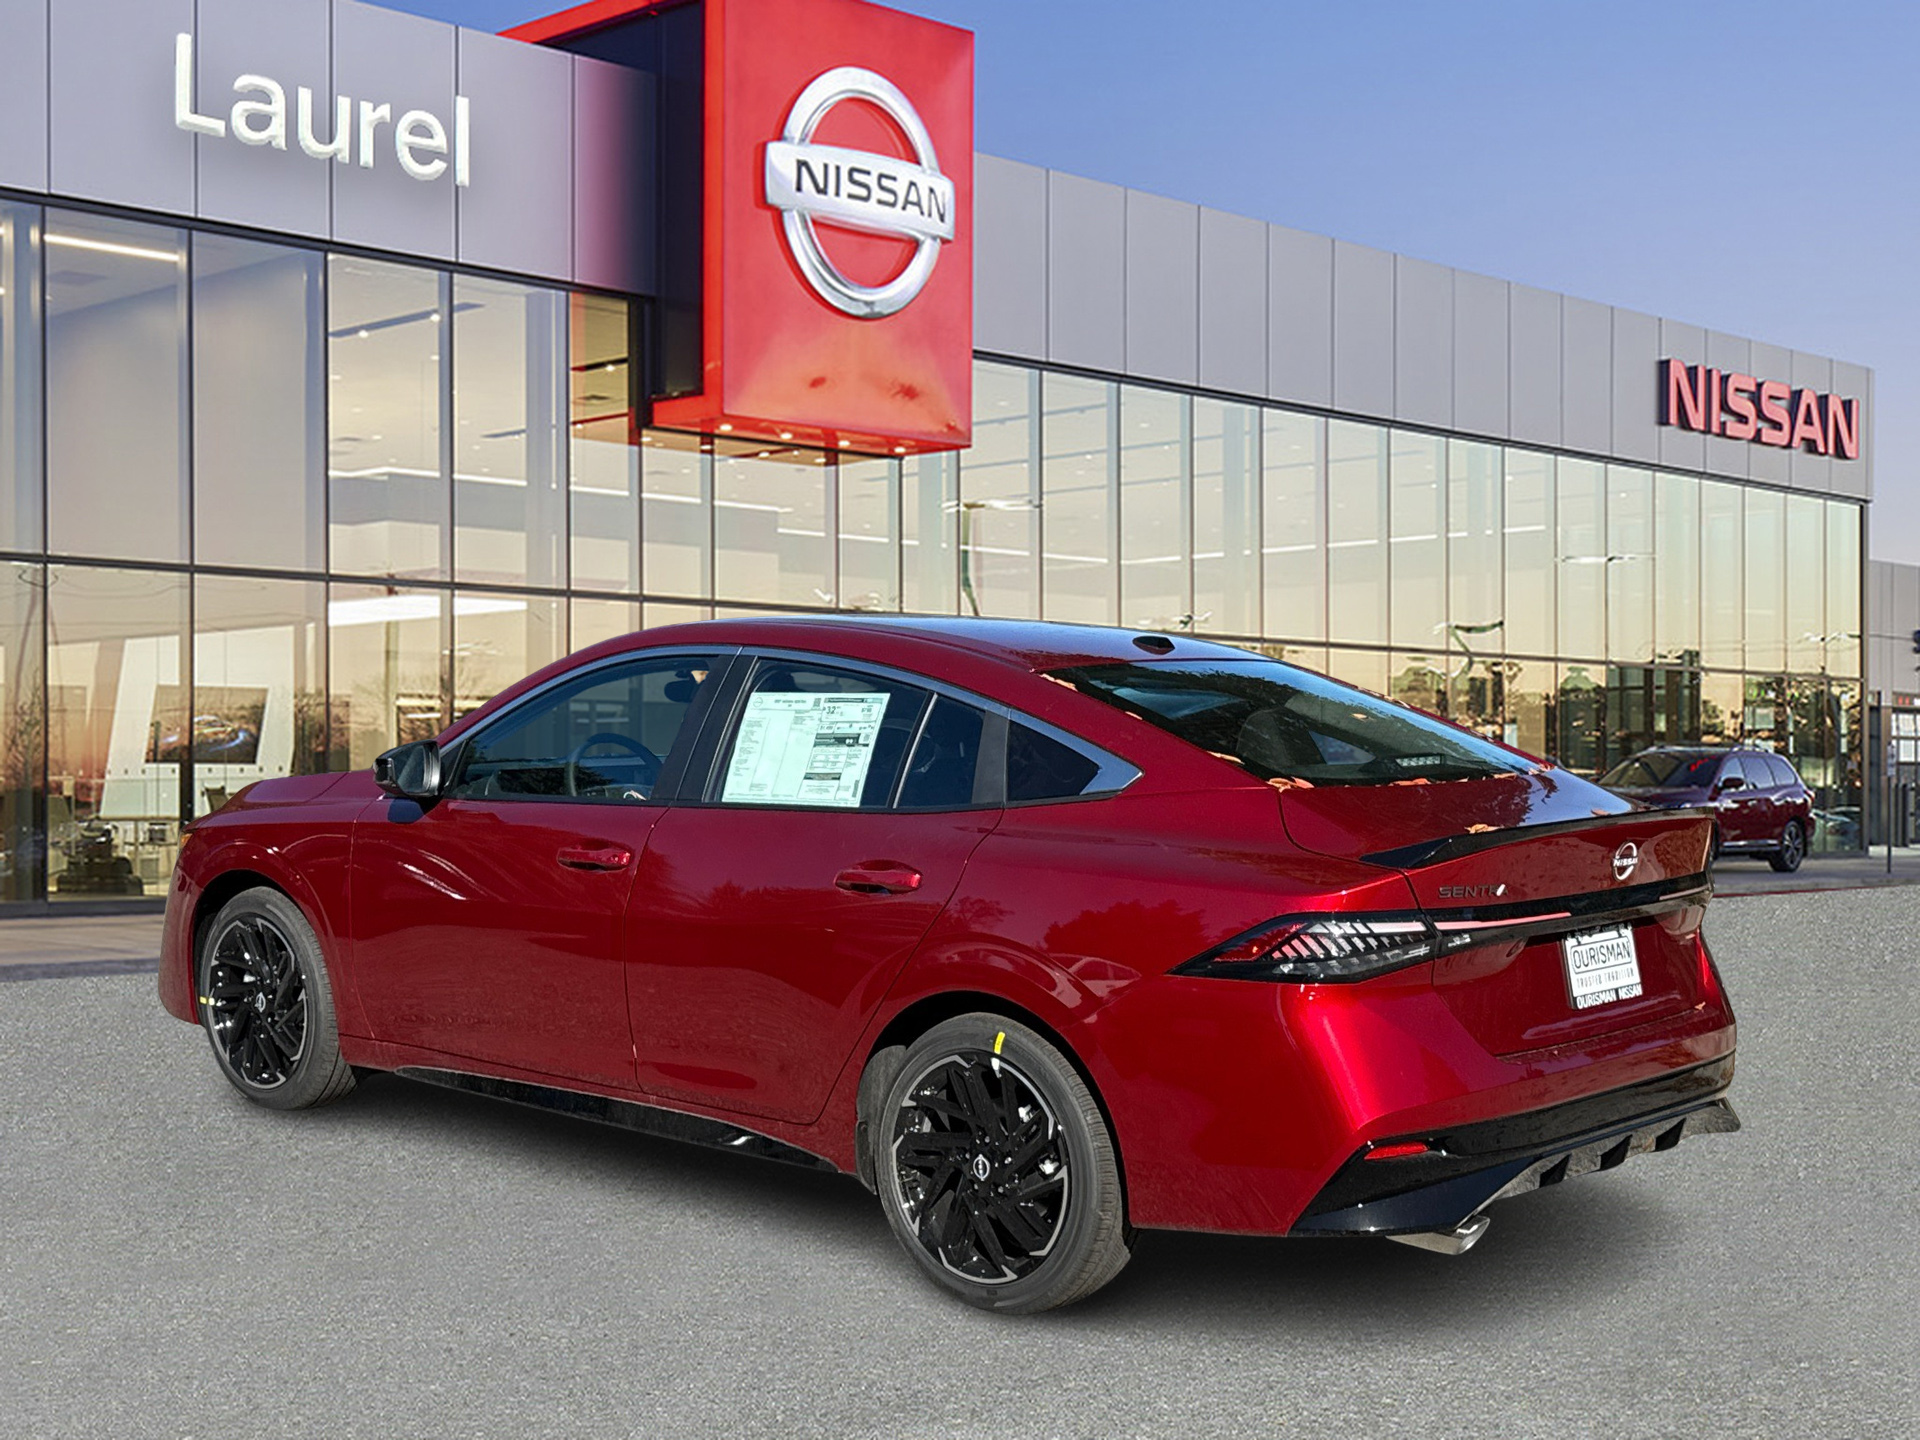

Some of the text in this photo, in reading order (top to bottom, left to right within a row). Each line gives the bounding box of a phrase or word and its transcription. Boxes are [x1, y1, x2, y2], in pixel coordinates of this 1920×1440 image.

[174, 32, 471, 188] Laurel
[794, 158, 947, 224] NISSAN
[1660, 358, 1859, 460] NISSAN
[1572, 940, 1631, 969] OURISMAN
[1576, 988, 1618, 1010] OURISMAN
